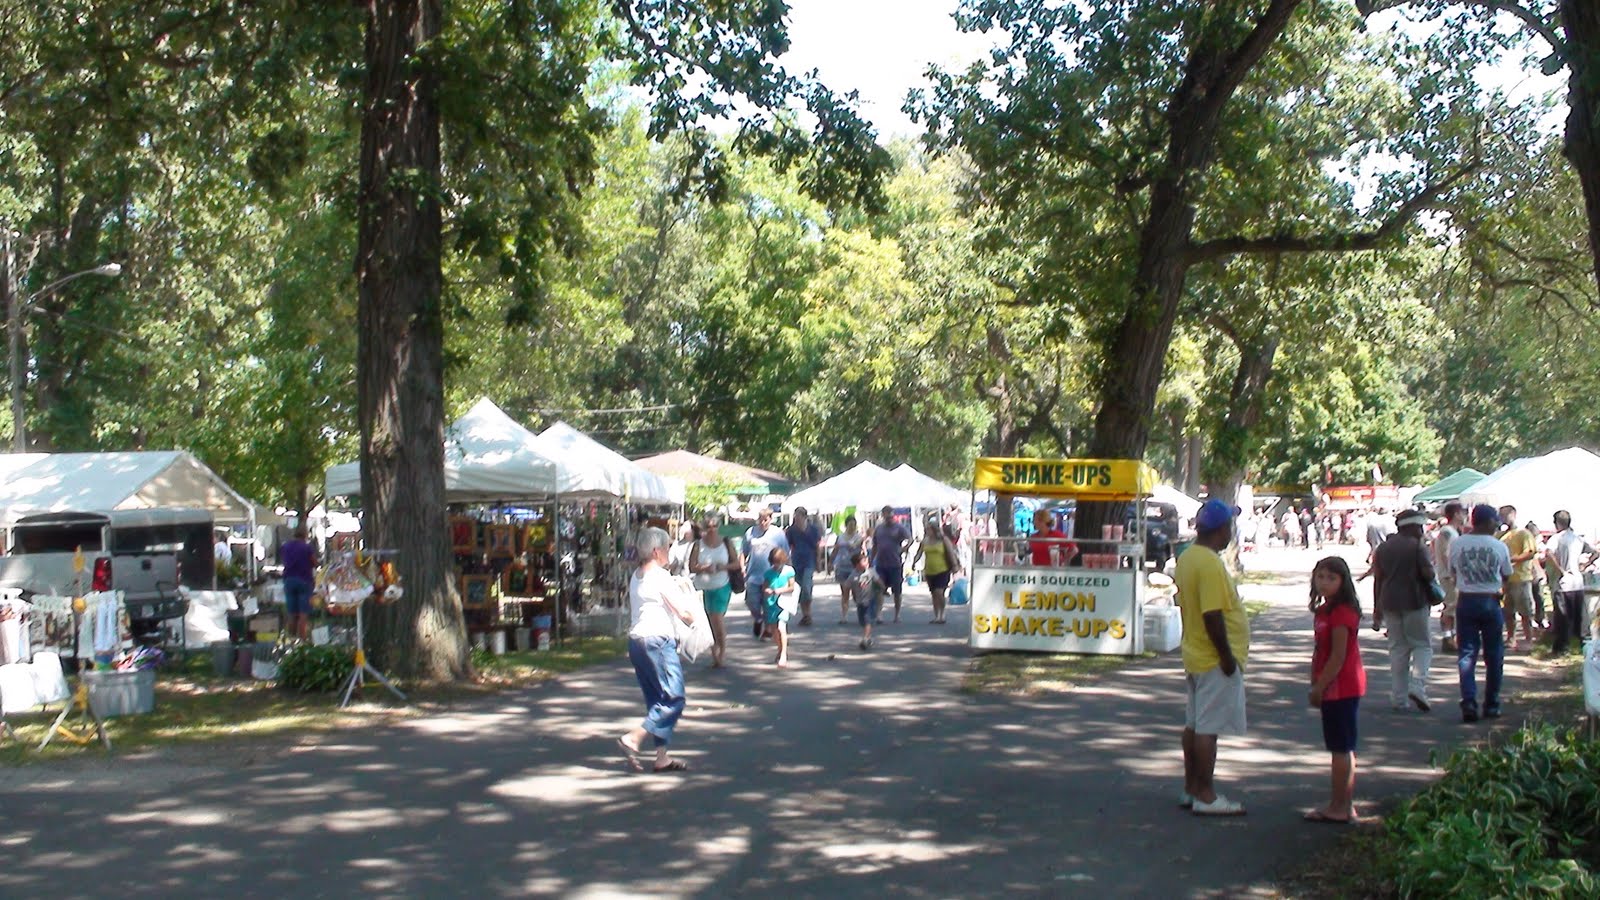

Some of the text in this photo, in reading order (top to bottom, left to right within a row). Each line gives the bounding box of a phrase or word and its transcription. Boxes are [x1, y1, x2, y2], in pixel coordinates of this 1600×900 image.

[1002, 464, 1111, 486] SHAKE-UPS
[994, 575, 1110, 587] FRESH SQUEEZED
[1003, 591, 1096, 612] LEMON
[974, 614, 1127, 639] SHAKE-UPS
